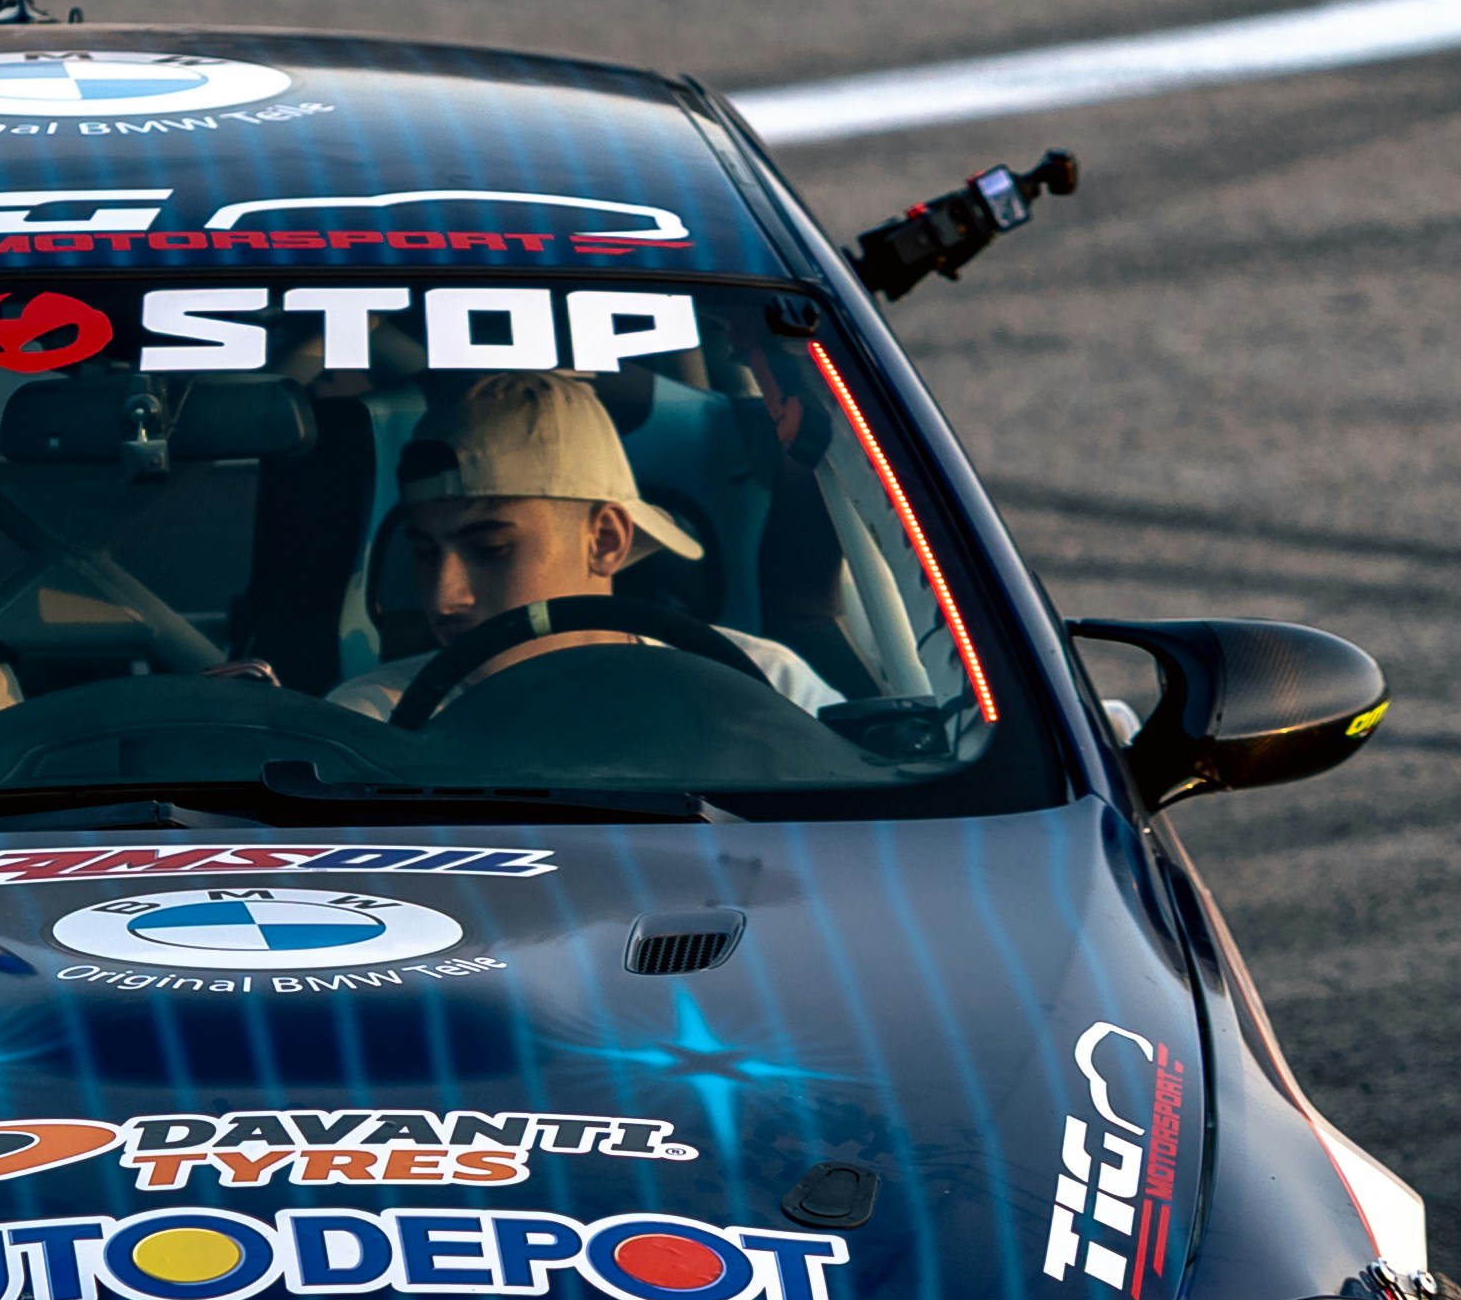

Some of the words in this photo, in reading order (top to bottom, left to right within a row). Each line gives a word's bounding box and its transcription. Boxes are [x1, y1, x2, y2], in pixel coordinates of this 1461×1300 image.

[78, 116, 219, 136] BMW
[138, 287, 702, 371] STOP
[92, 888, 402, 916] BMW
[56, 962, 252, 993] Original
[272, 968, 404, 994] BMW
[405, 953, 508, 980] Teile
[138, 1114, 666, 1157] DAVANTI
[1144, 1072, 1183, 1201] MOTORSPORT
[144, 1149, 524, 1185] TYRES
